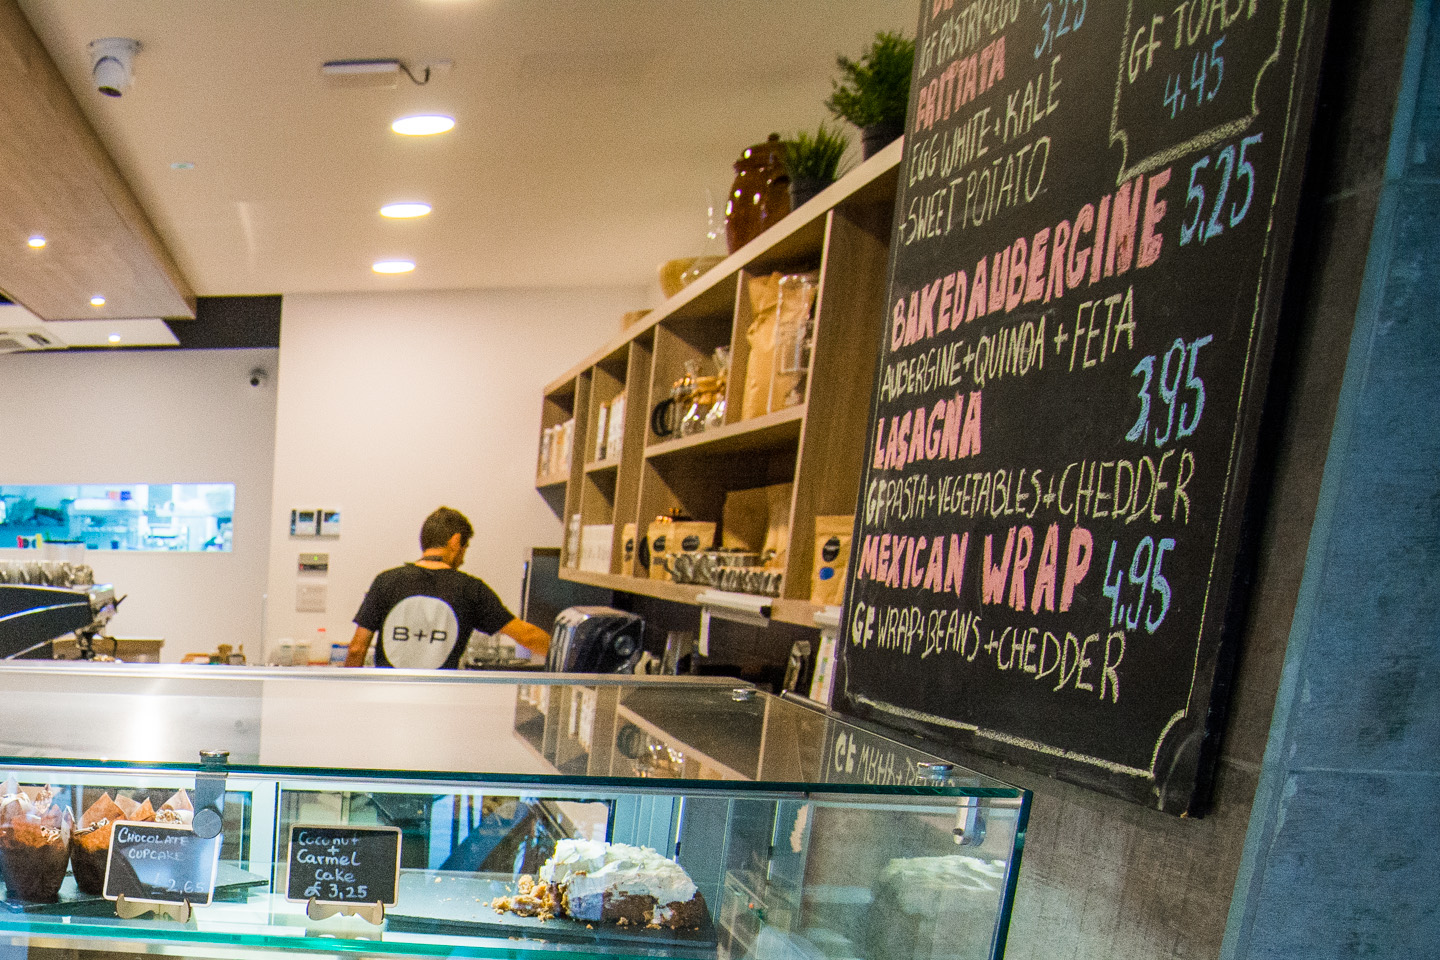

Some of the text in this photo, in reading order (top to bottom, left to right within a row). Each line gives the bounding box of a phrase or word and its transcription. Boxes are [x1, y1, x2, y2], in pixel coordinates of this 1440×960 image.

[1128, 14, 1164, 84] GF
[910, 133, 940, 187] EGG
[1003, 54, 1062, 144] KALE
[963, 136, 1051, 229] POTATO
[1069, 285, 1137, 372] FETA
[873, 390, 982, 471] LASAGNA
[857, 522, 1094, 615] MEXICAN WRAP
[393, 626, 447, 643] B+P
[852, 601, 875, 649] GF
